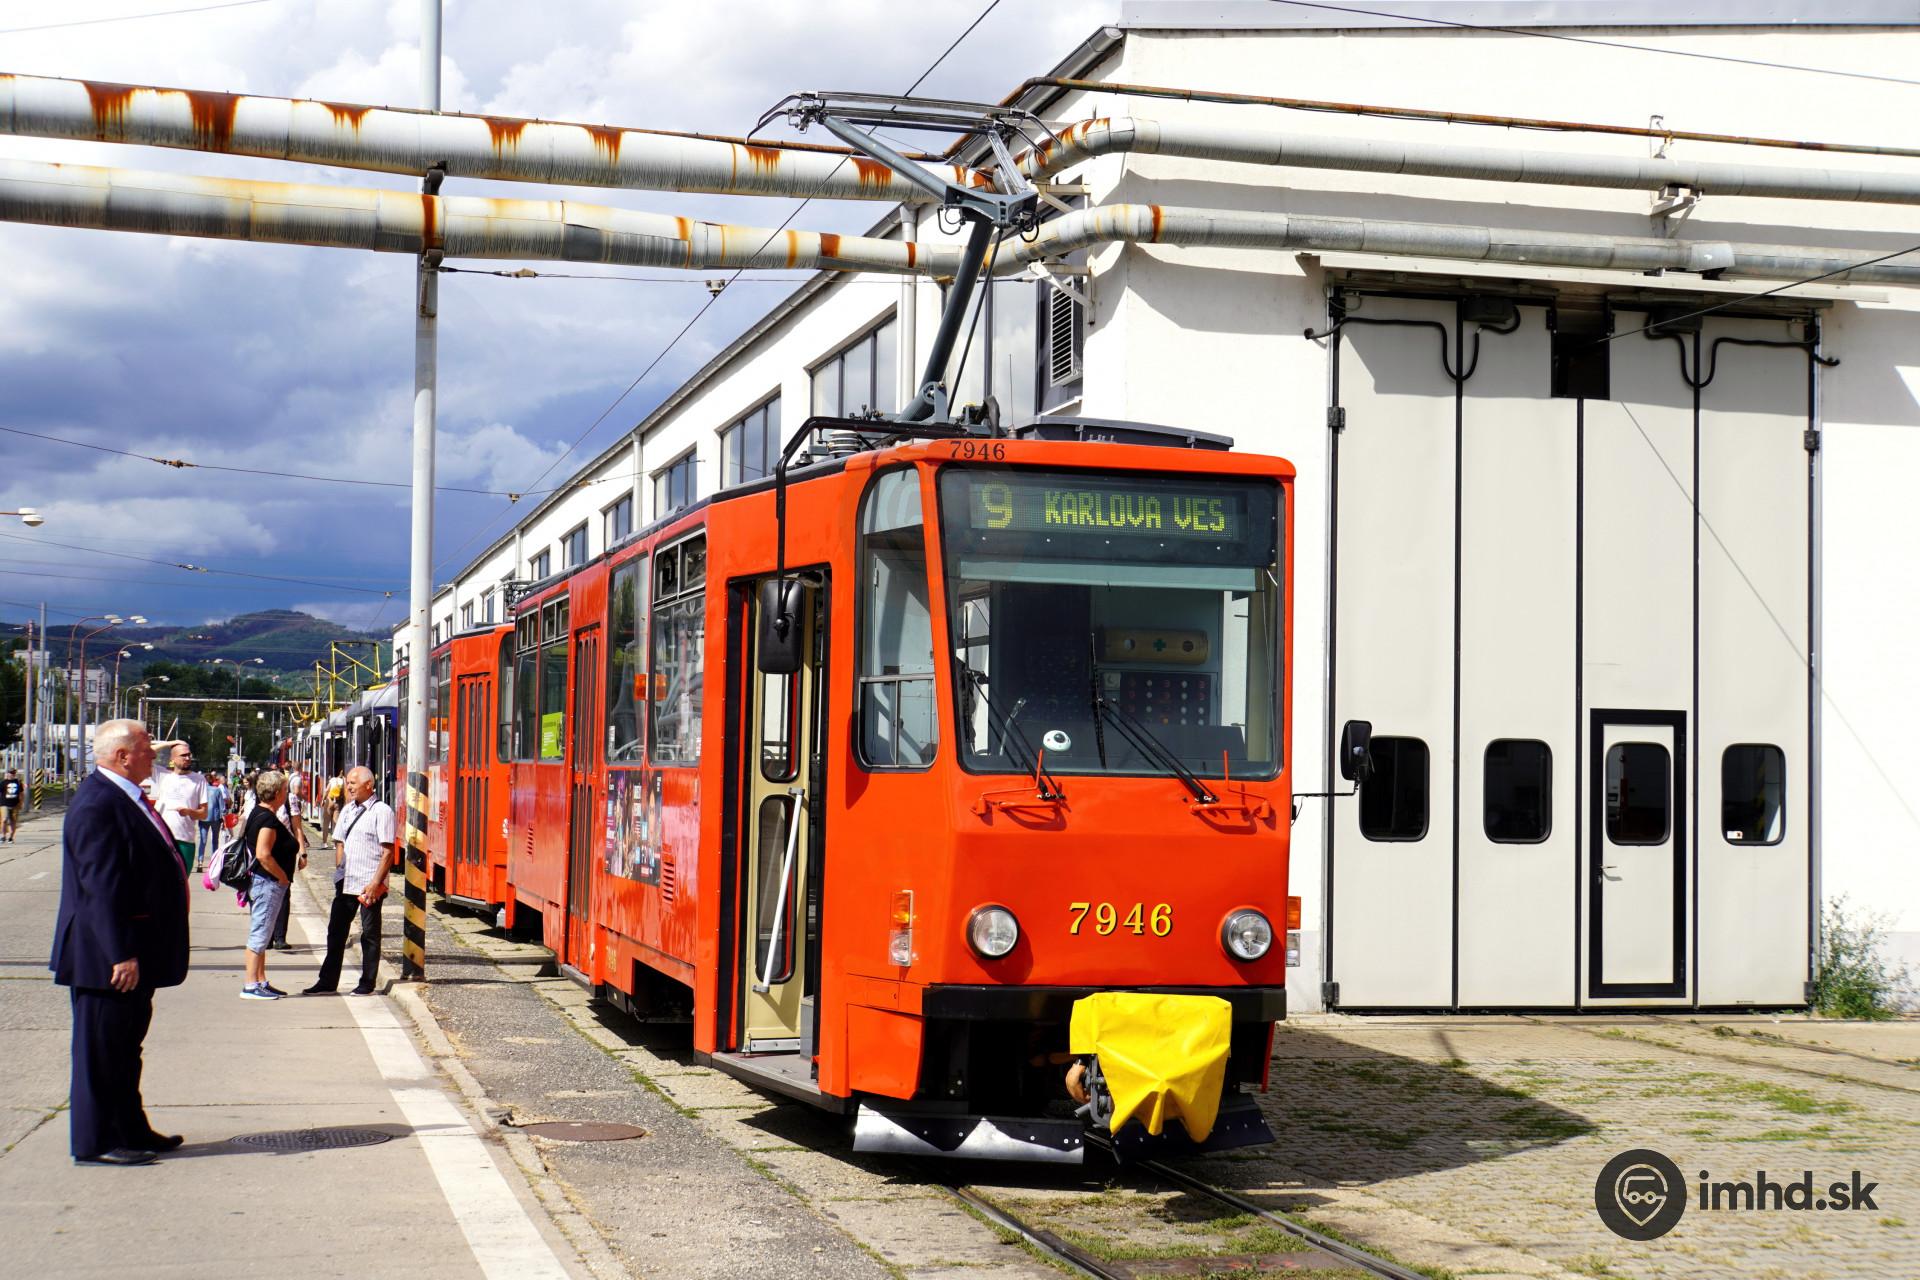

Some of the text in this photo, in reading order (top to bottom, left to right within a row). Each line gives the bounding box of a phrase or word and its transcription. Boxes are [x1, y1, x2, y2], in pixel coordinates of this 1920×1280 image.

[949, 440, 1006, 461] 7946
[981, 481, 1226, 532] 9 KARLOVA VES
[1068, 902, 1174, 937] 7946
